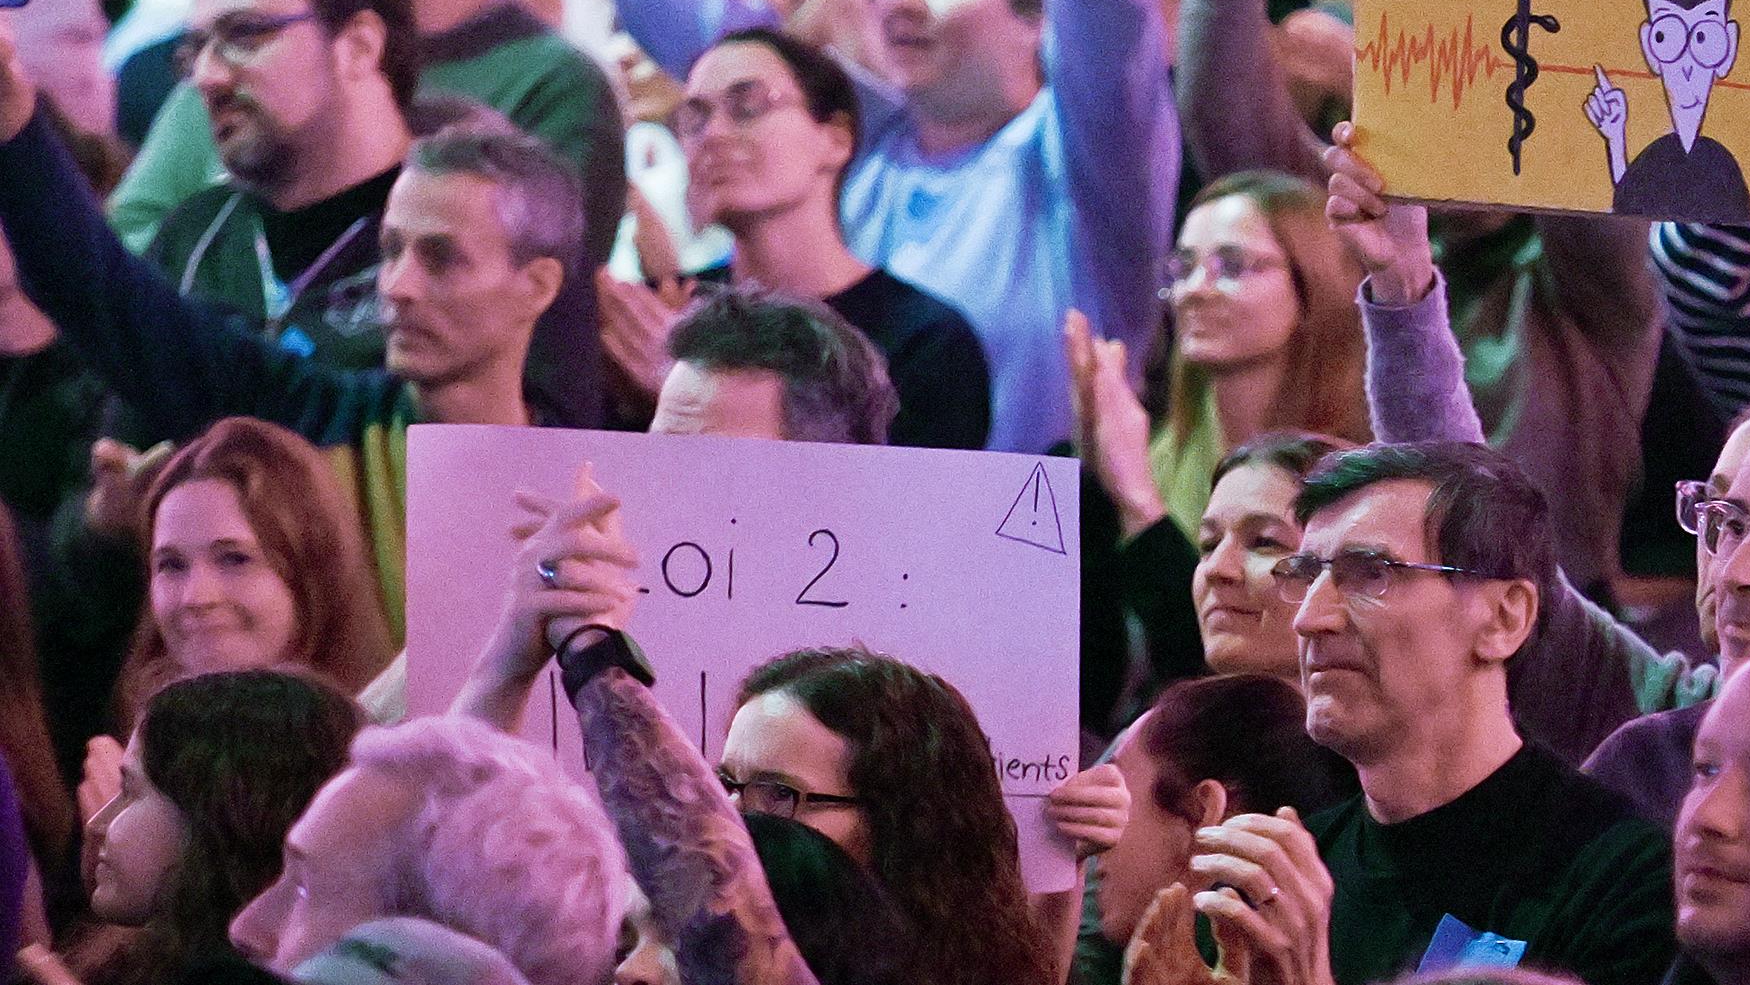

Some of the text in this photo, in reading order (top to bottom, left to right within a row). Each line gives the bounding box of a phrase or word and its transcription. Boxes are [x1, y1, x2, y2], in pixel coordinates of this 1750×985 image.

[637, 518, 737, 599] oi
[795, 529, 849, 608] 2
[990, 744, 1070, 782] ients
